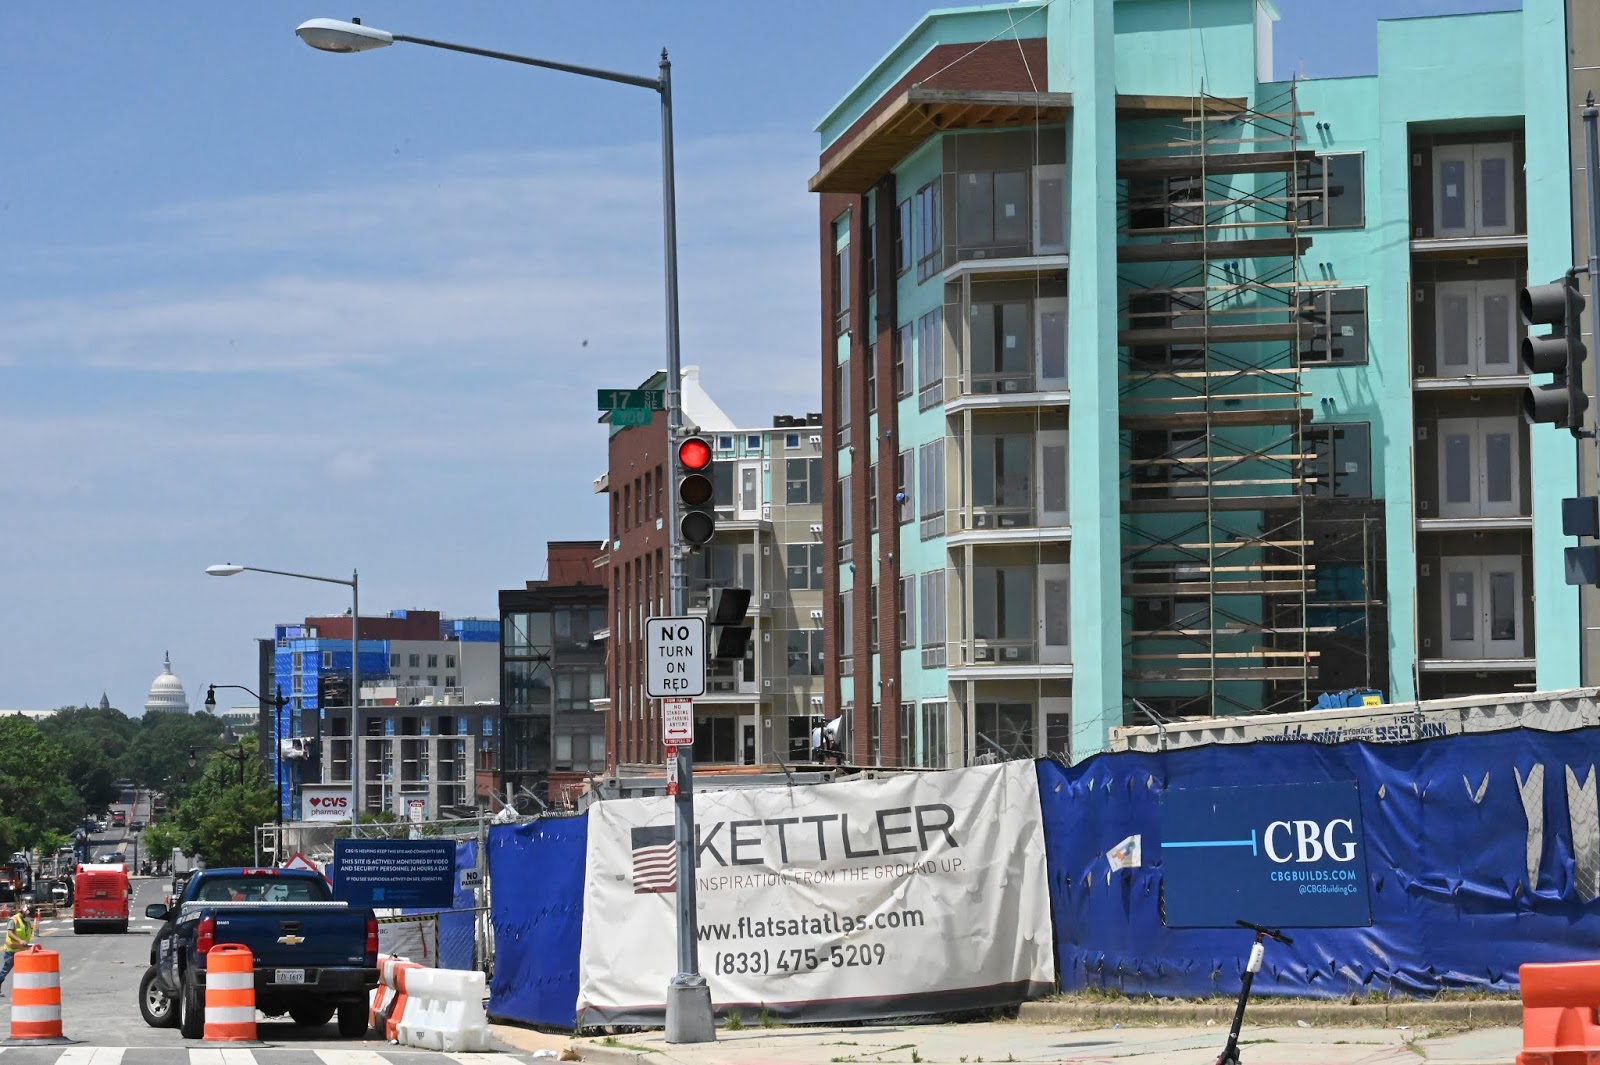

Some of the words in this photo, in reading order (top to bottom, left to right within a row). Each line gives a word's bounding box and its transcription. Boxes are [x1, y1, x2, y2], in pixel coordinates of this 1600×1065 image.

[609, 391, 631, 409] 17
[644, 391, 657, 400] ST
[644, 401, 657, 409] NE
[662, 626, 689, 641] NO
[659, 646, 693, 657] TURN
[667, 662, 685, 673] ON
[663, 678, 689, 690] RED
[1343, 728, 1374, 736] STORAGE
[322, 797, 347, 807] CVS
[311, 808, 346, 816] pharmacy
[694, 803, 960, 868] KETTLER
[1264, 818, 1357, 863] CBG
[466, 871, 478, 880] NO
[795, 870, 835, 884] FROM
[842, 866, 869, 881] THE
[874, 860, 937, 879] GROUND
[941, 858, 966, 874] UP.
[1270, 870, 1356, 881] CBGBUILDS.COM
[1298, 884, 1357, 896] @CBGBuildingCo
[696, 908, 925, 941] ww.flatsatatlas.com
[715, 949, 769, 977] (833)
[776, 943, 886, 972] 475-5209
